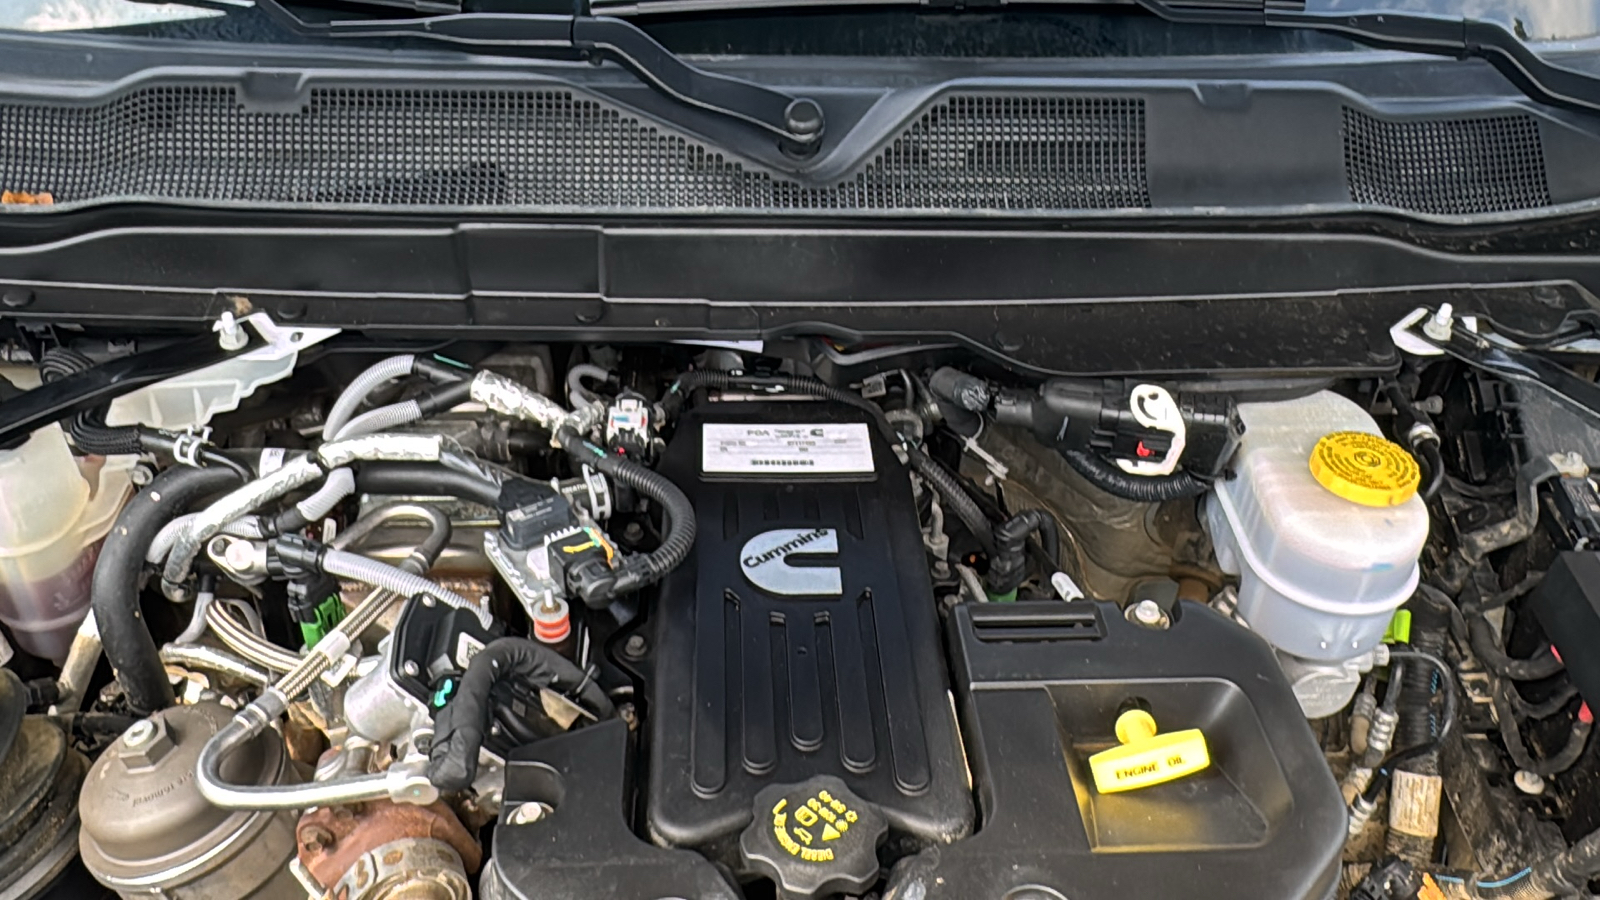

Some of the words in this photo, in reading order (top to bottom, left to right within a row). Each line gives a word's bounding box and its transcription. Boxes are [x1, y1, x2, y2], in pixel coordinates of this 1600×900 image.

[743, 528, 828, 568] Cummins
[1115, 763, 1157, 779] ENGINE
[1167, 756, 1185, 767] OIL
